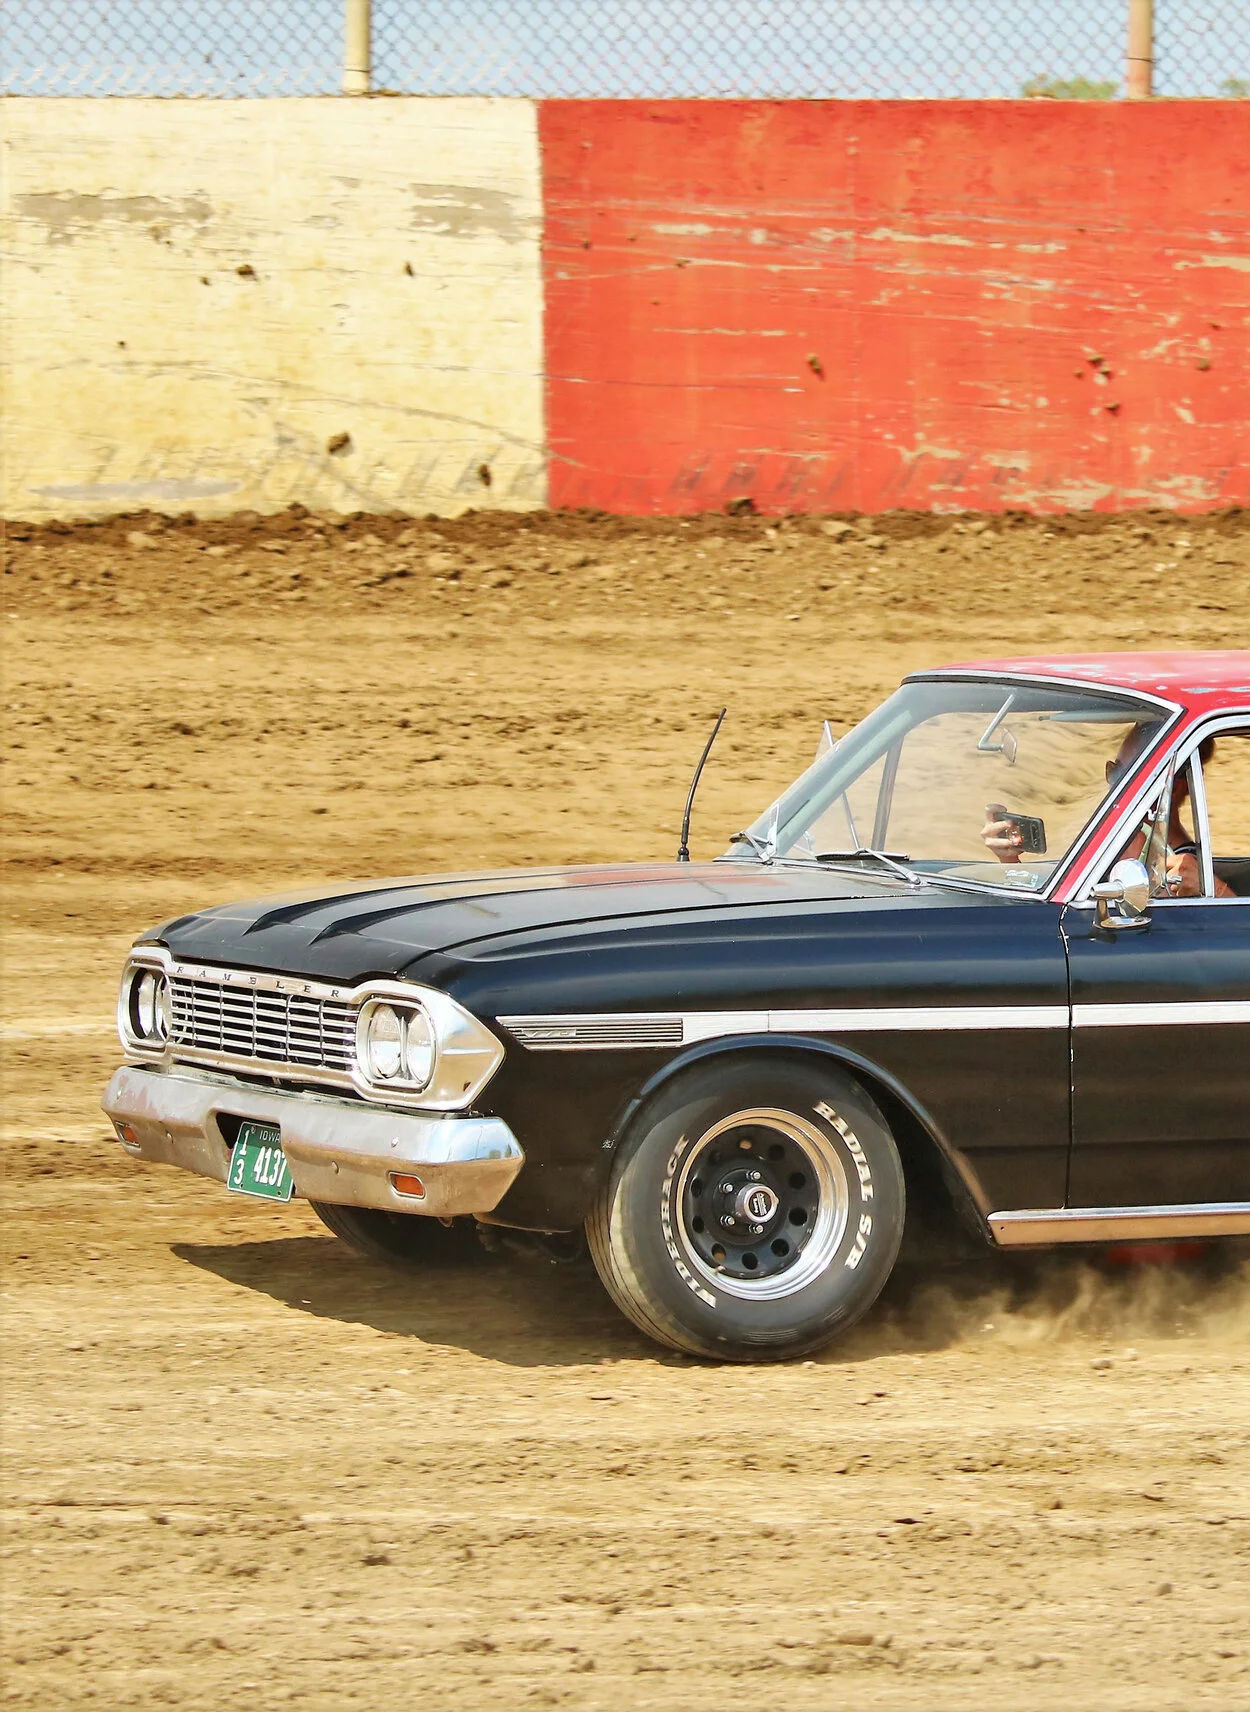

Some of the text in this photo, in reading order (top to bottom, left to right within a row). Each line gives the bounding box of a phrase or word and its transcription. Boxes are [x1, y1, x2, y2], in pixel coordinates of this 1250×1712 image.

[176, 966, 340, 998] RAMBLER
[253, 1146, 288, 1188] 4137
[811, 1100, 875, 1202] RADIAL
